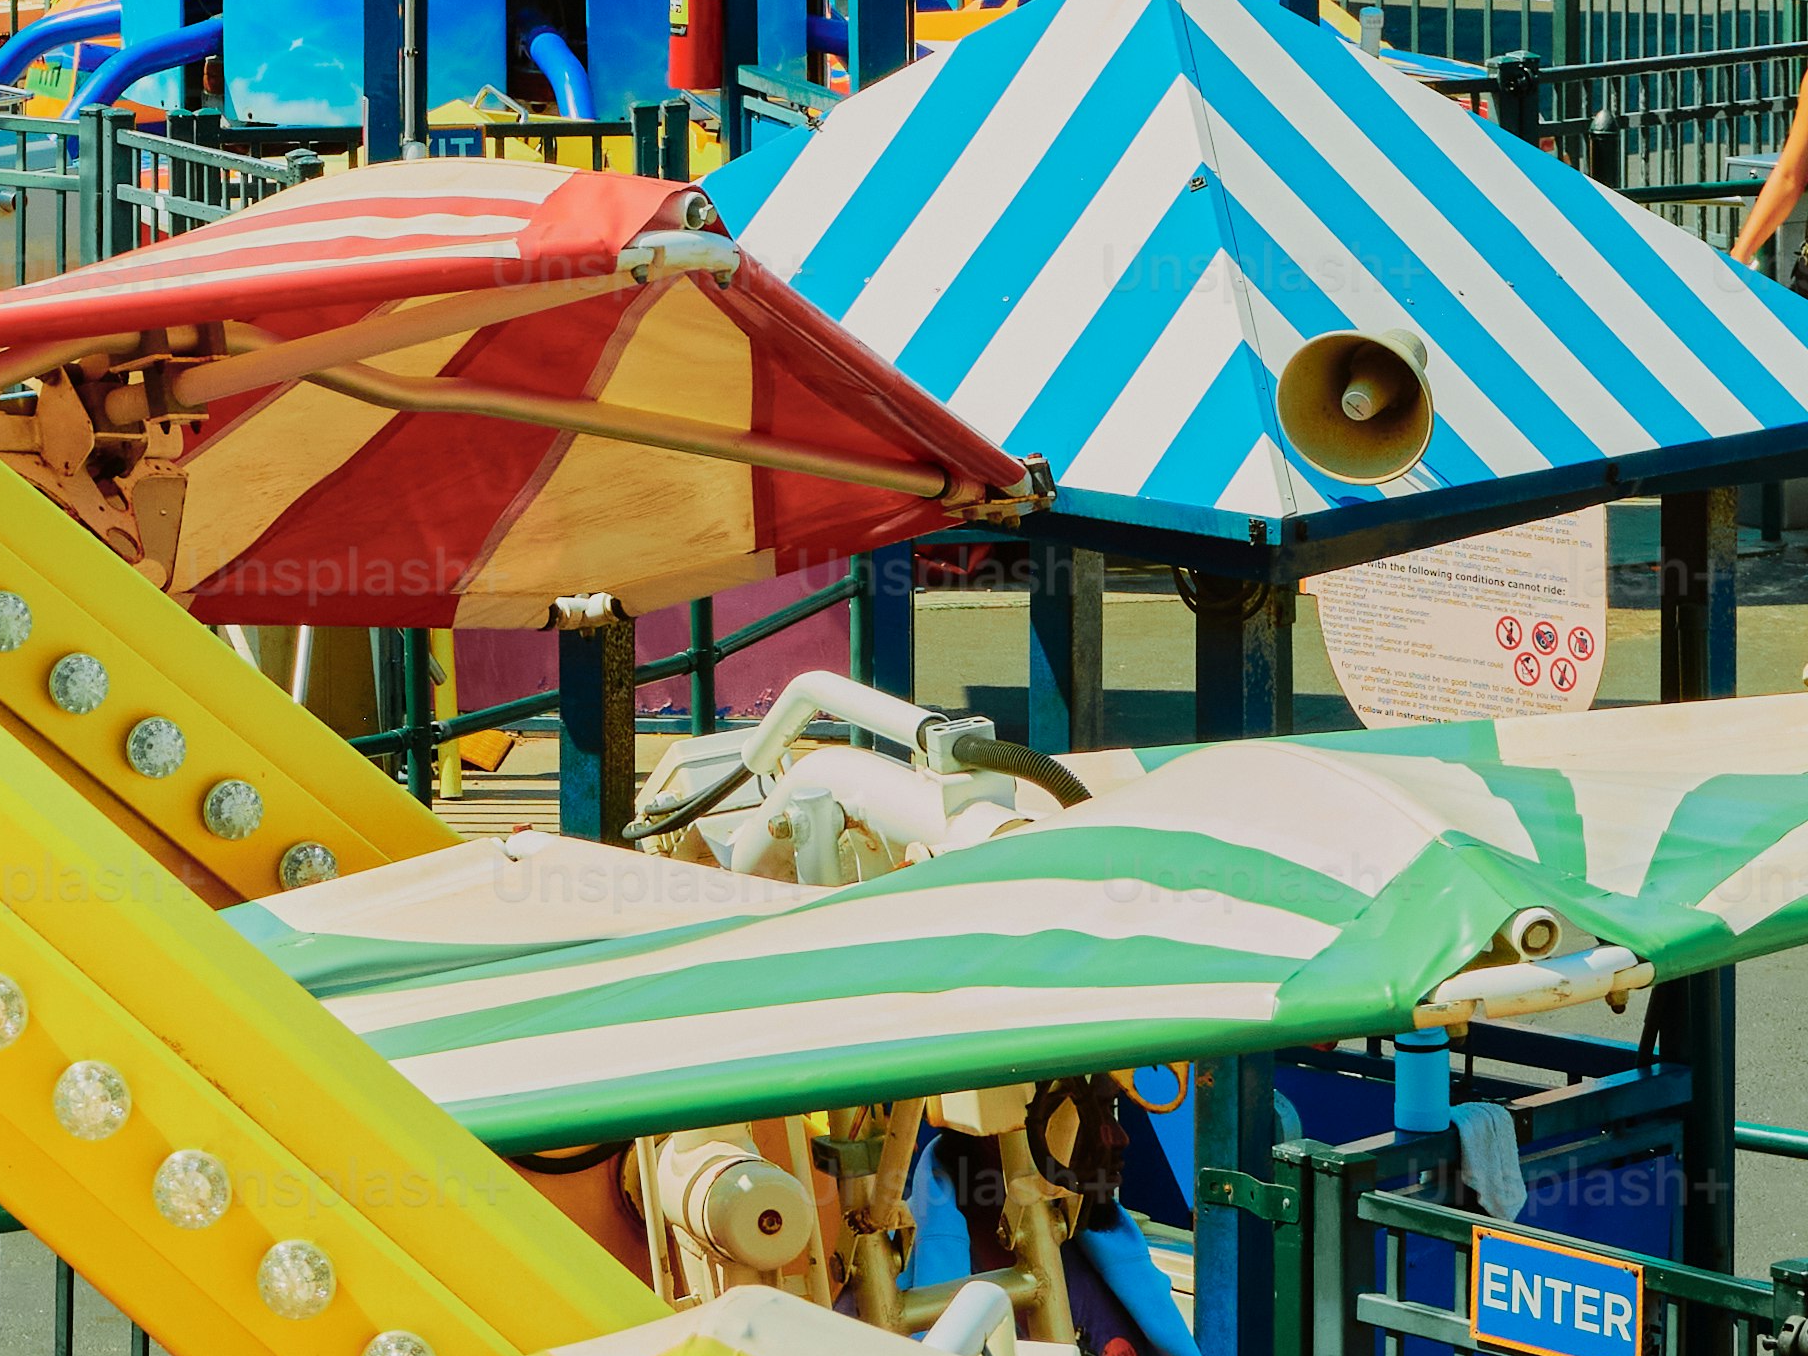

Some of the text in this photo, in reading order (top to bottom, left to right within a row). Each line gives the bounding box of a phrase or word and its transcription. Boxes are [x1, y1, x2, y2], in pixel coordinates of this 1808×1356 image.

[430, 137, 474, 156] IT
[1390, 562, 1405, 573] the
[1408, 564, 1452, 581] following
[1455, 573, 1505, 587] conditions
[1507, 580, 1540, 592] cannot
[1543, 585, 1566, 596] ride:
[1341, 661, 1352, 669] For
[1354, 664, 1369, 673] your
[1394, 670, 1407, 678] you
[1409, 671, 1430, 681] should
[1432, 674, 1441, 683] be
[1443, 676, 1449, 684] in
[1451, 678, 1467, 688] good
[1469, 680, 1490, 690] health
[1492, 684, 1499, 692] to
[1519, 688, 1534, 699] Only
[1536, 692, 1549, 701] you
[1550, 692, 1568, 703] know
[1358, 704, 1441, 723] Follow all instructions
[1482, 1262, 1633, 1342] ENTER
